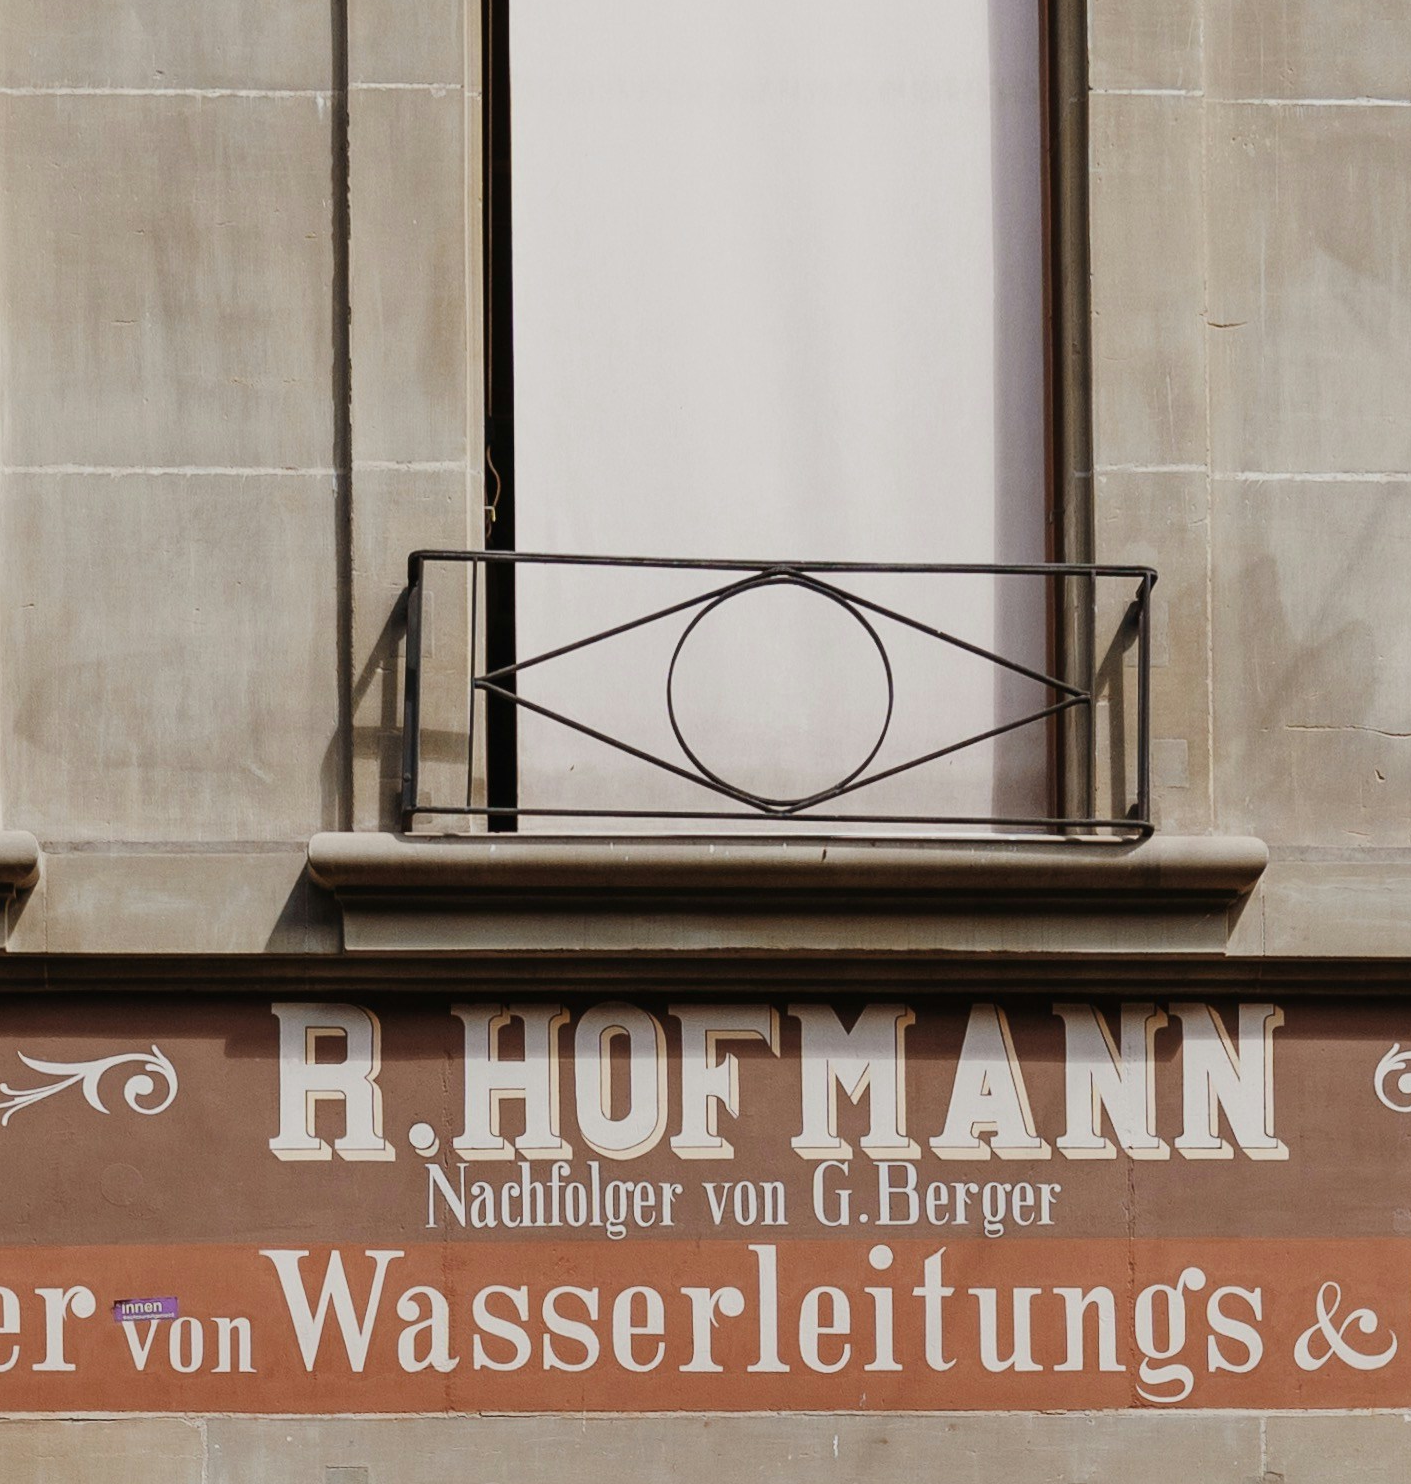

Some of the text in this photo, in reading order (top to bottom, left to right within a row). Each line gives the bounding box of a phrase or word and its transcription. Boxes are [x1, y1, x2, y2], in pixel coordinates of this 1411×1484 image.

[425, 1159, 684, 1241] Nachfolger
[702, 1179, 788, 1233] von
[119, 1314, 258, 1374] von
[258, 1242, 1265, 1405] Wasserleitungs
[1293, 1278, 1400, 1374] &
